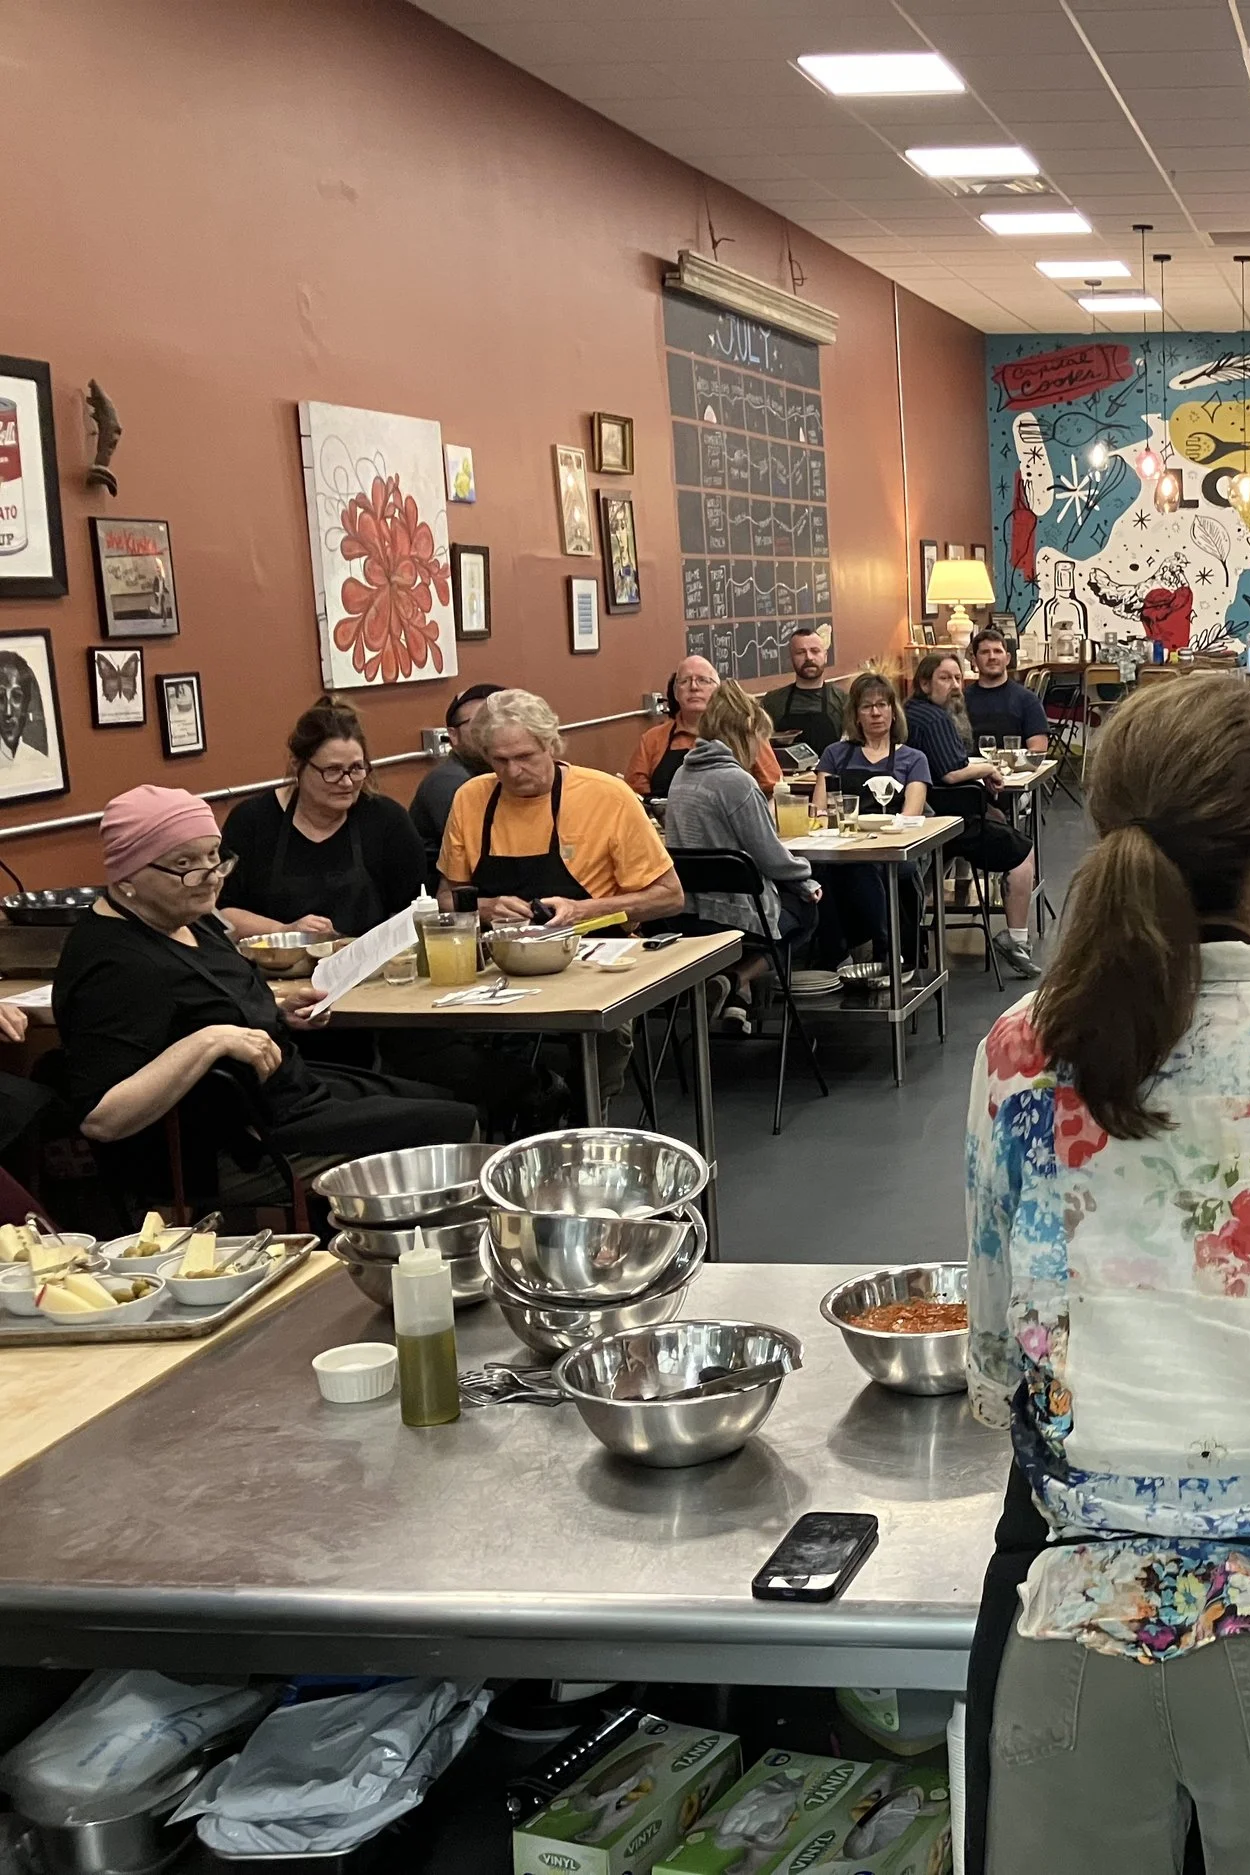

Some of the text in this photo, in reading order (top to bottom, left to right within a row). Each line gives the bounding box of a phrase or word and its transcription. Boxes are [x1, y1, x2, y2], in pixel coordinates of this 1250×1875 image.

[716, 314, 771, 369] JULY
[675, 1737, 717, 1769] VINYL
[806, 1765, 854, 1808] VINYL
[627, 1821, 662, 1853] VINYL
[790, 1832, 835, 1870] VINYL
[542, 1853, 578, 1870] VINYL
